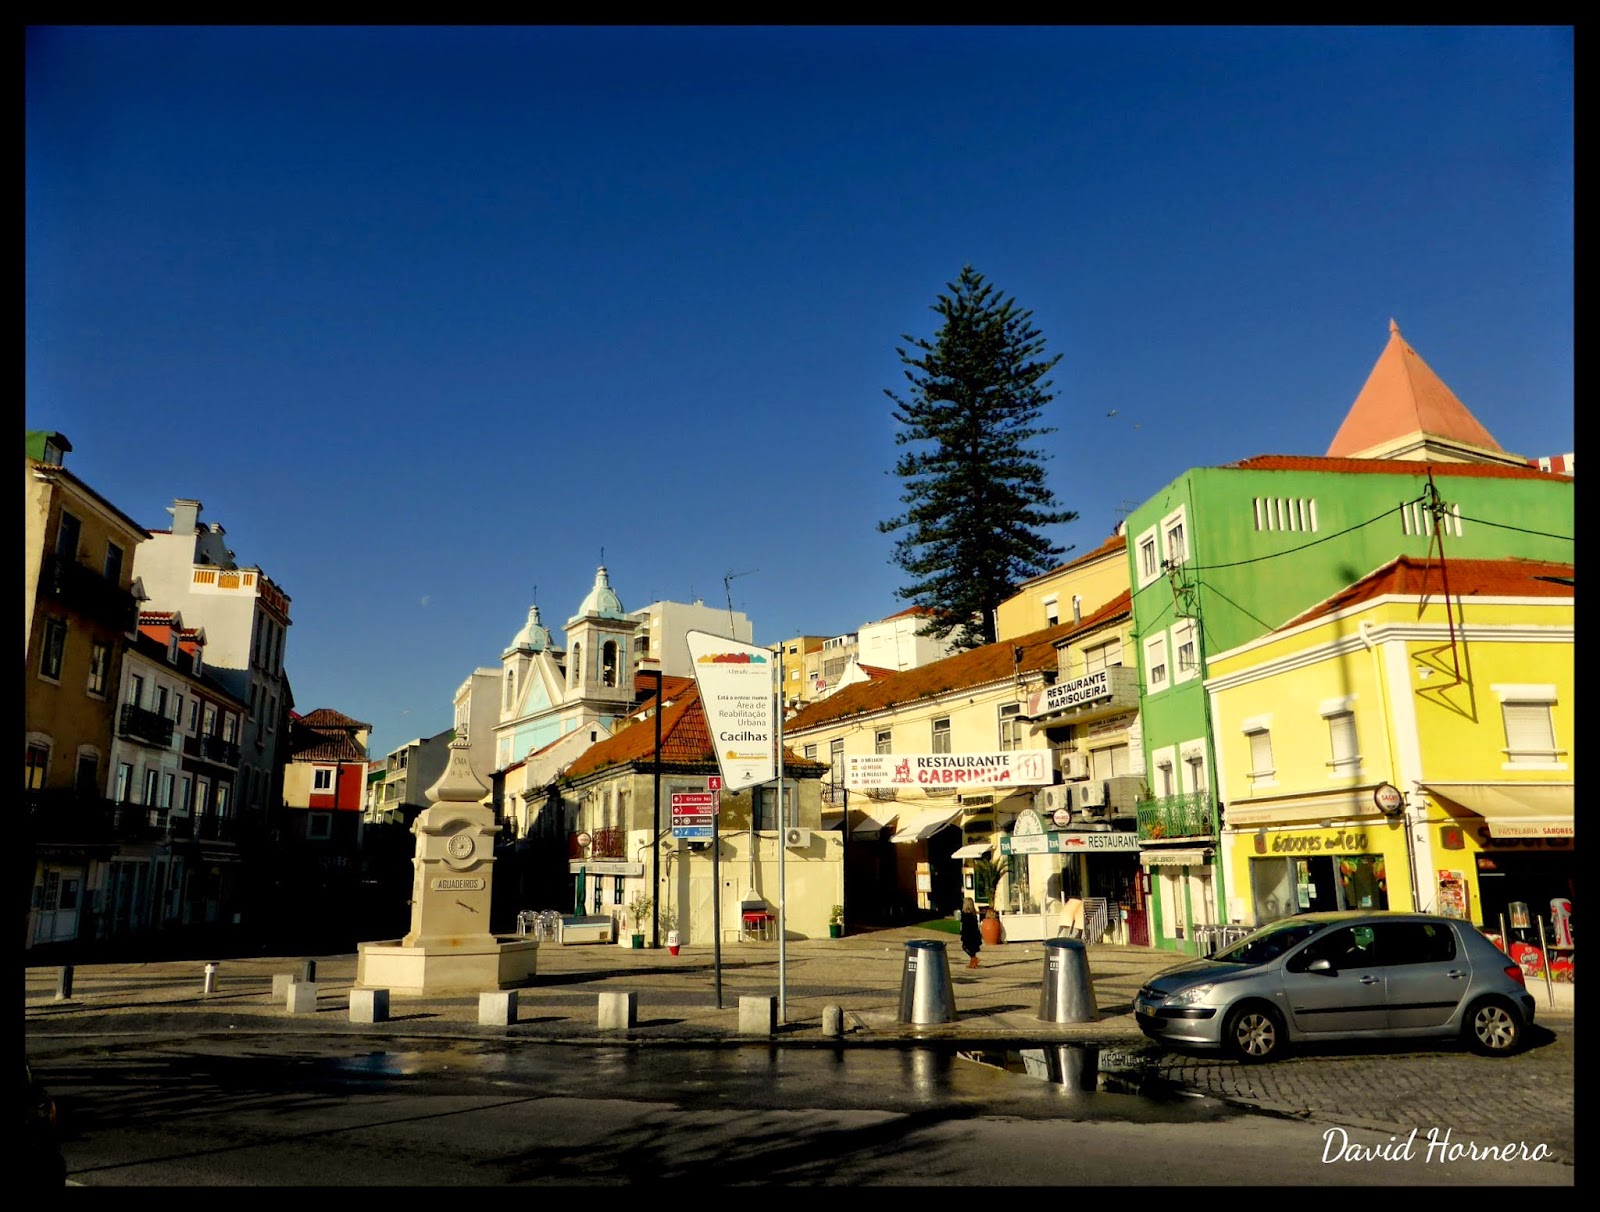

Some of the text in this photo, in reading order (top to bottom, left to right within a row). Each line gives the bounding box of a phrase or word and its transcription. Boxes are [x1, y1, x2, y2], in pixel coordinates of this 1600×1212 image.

[1047, 672, 1107, 699] RESTAURANTE
[1047, 684, 1107, 710] MARISQUEIRA
[736, 700, 767, 709] Área de
[719, 710, 767, 720] Reabilitação
[737, 718, 767, 727] Urbana
[719, 731, 768, 742] Cacilhas
[917, 754, 1010, 768] RESTAURANTE
[1542, 827, 1573, 835] SABORES
[1272, 833, 1321, 853] Sabores
[437, 879, 479, 889] AGUADEIROS
